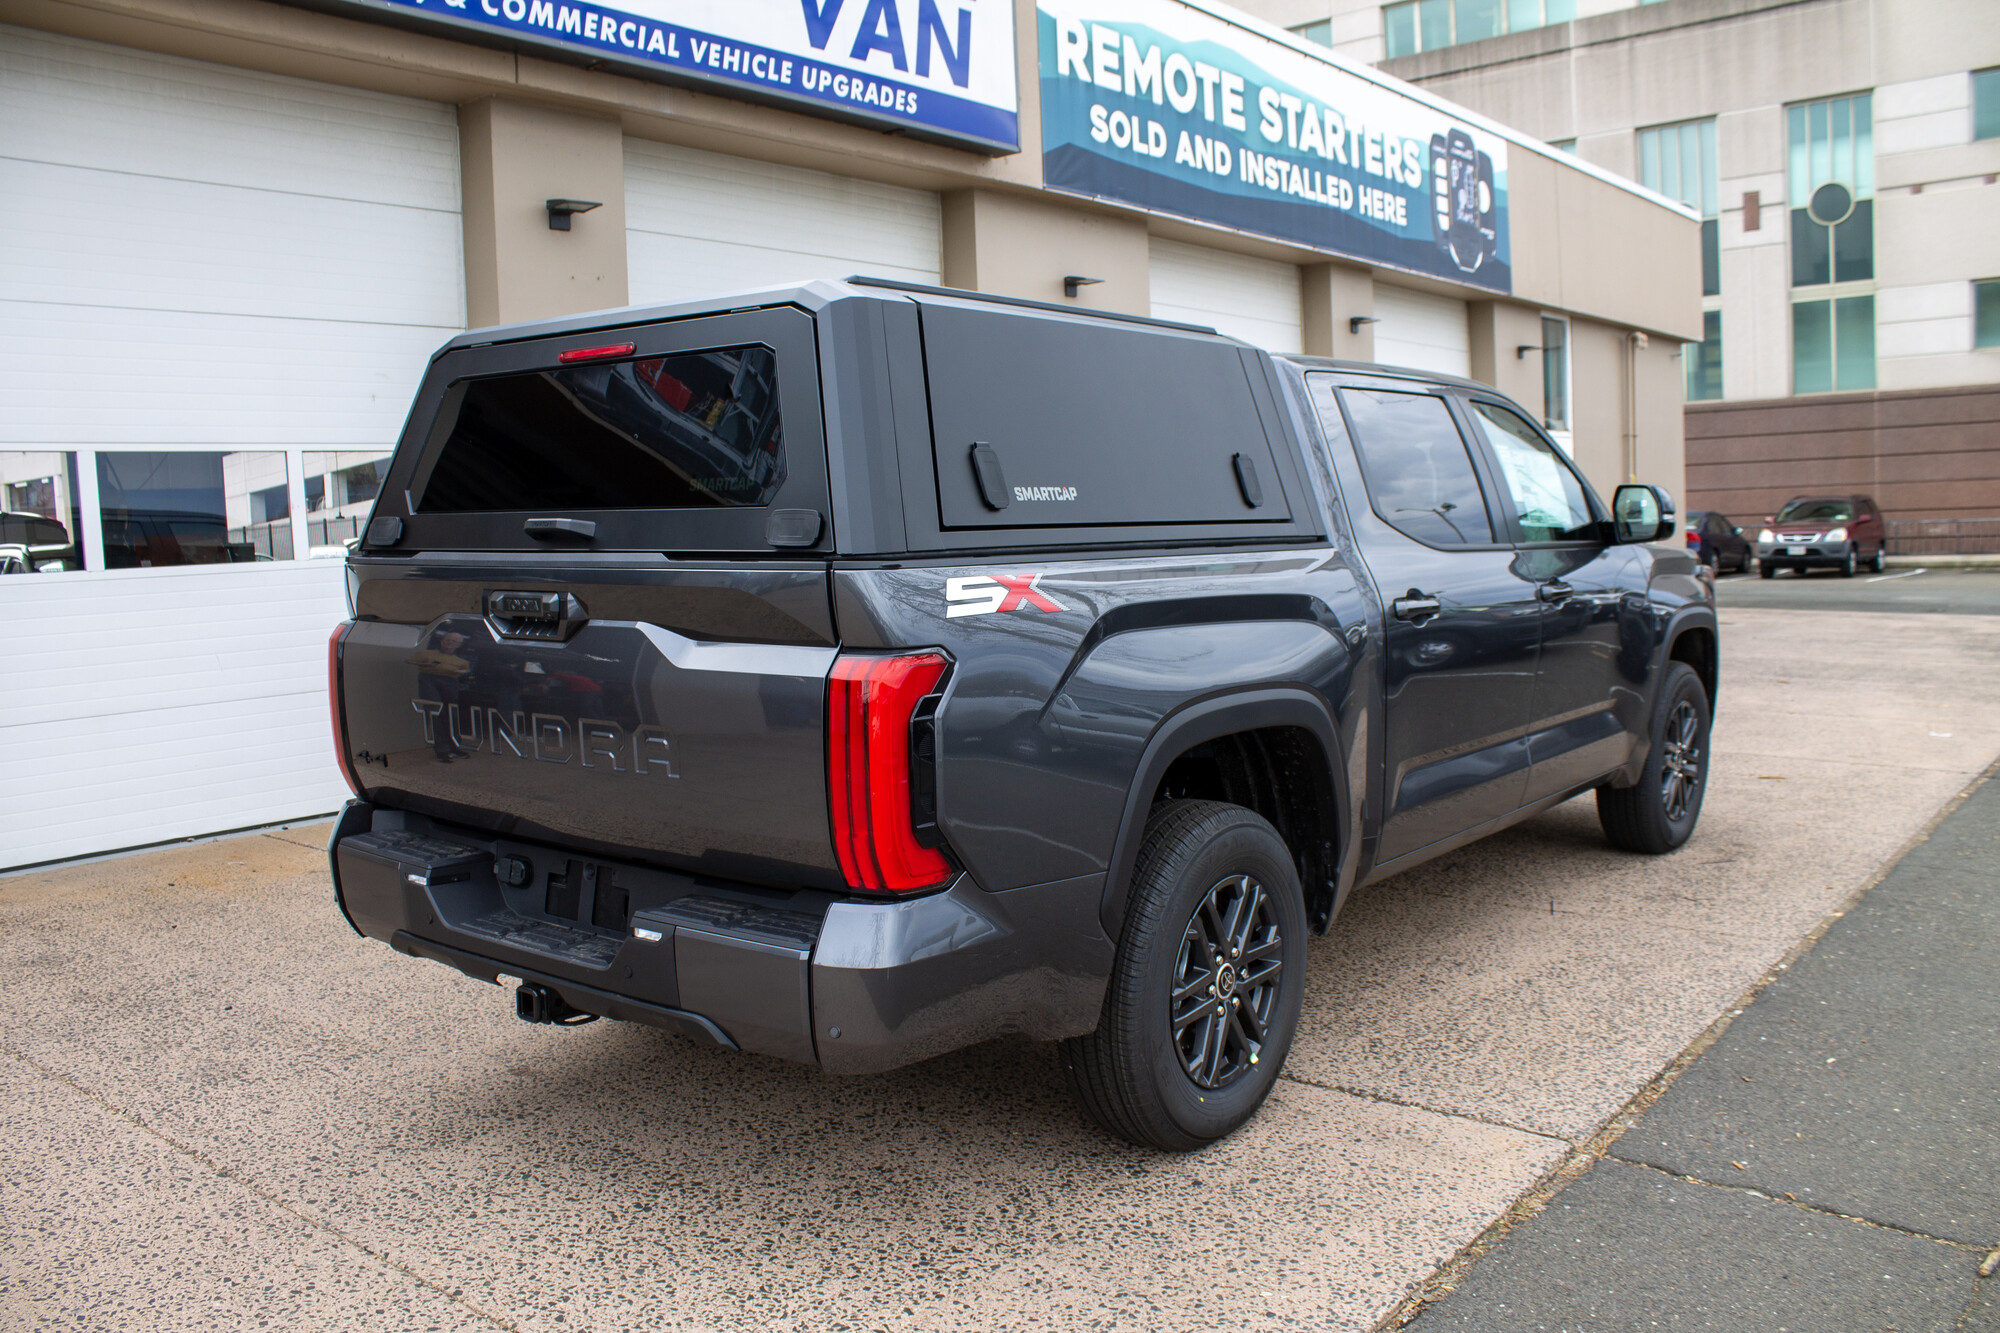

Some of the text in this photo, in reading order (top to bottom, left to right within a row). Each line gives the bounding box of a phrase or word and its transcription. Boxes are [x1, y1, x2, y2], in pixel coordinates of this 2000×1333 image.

[482, 0, 918, 114] COMMERCIAL VEHICLE UPGRADES
[801, 0, 972, 89] VAN
[1055, 17, 1422, 189] REMOTE STARTERS
[1090, 104, 1407, 227] SOLD AND INSTALLED HERE
[689, 477, 755, 492] SMARTCAP
[1014, 486, 1078, 502] SMARTCAP
[411, 699, 681, 779] TUNDRA
